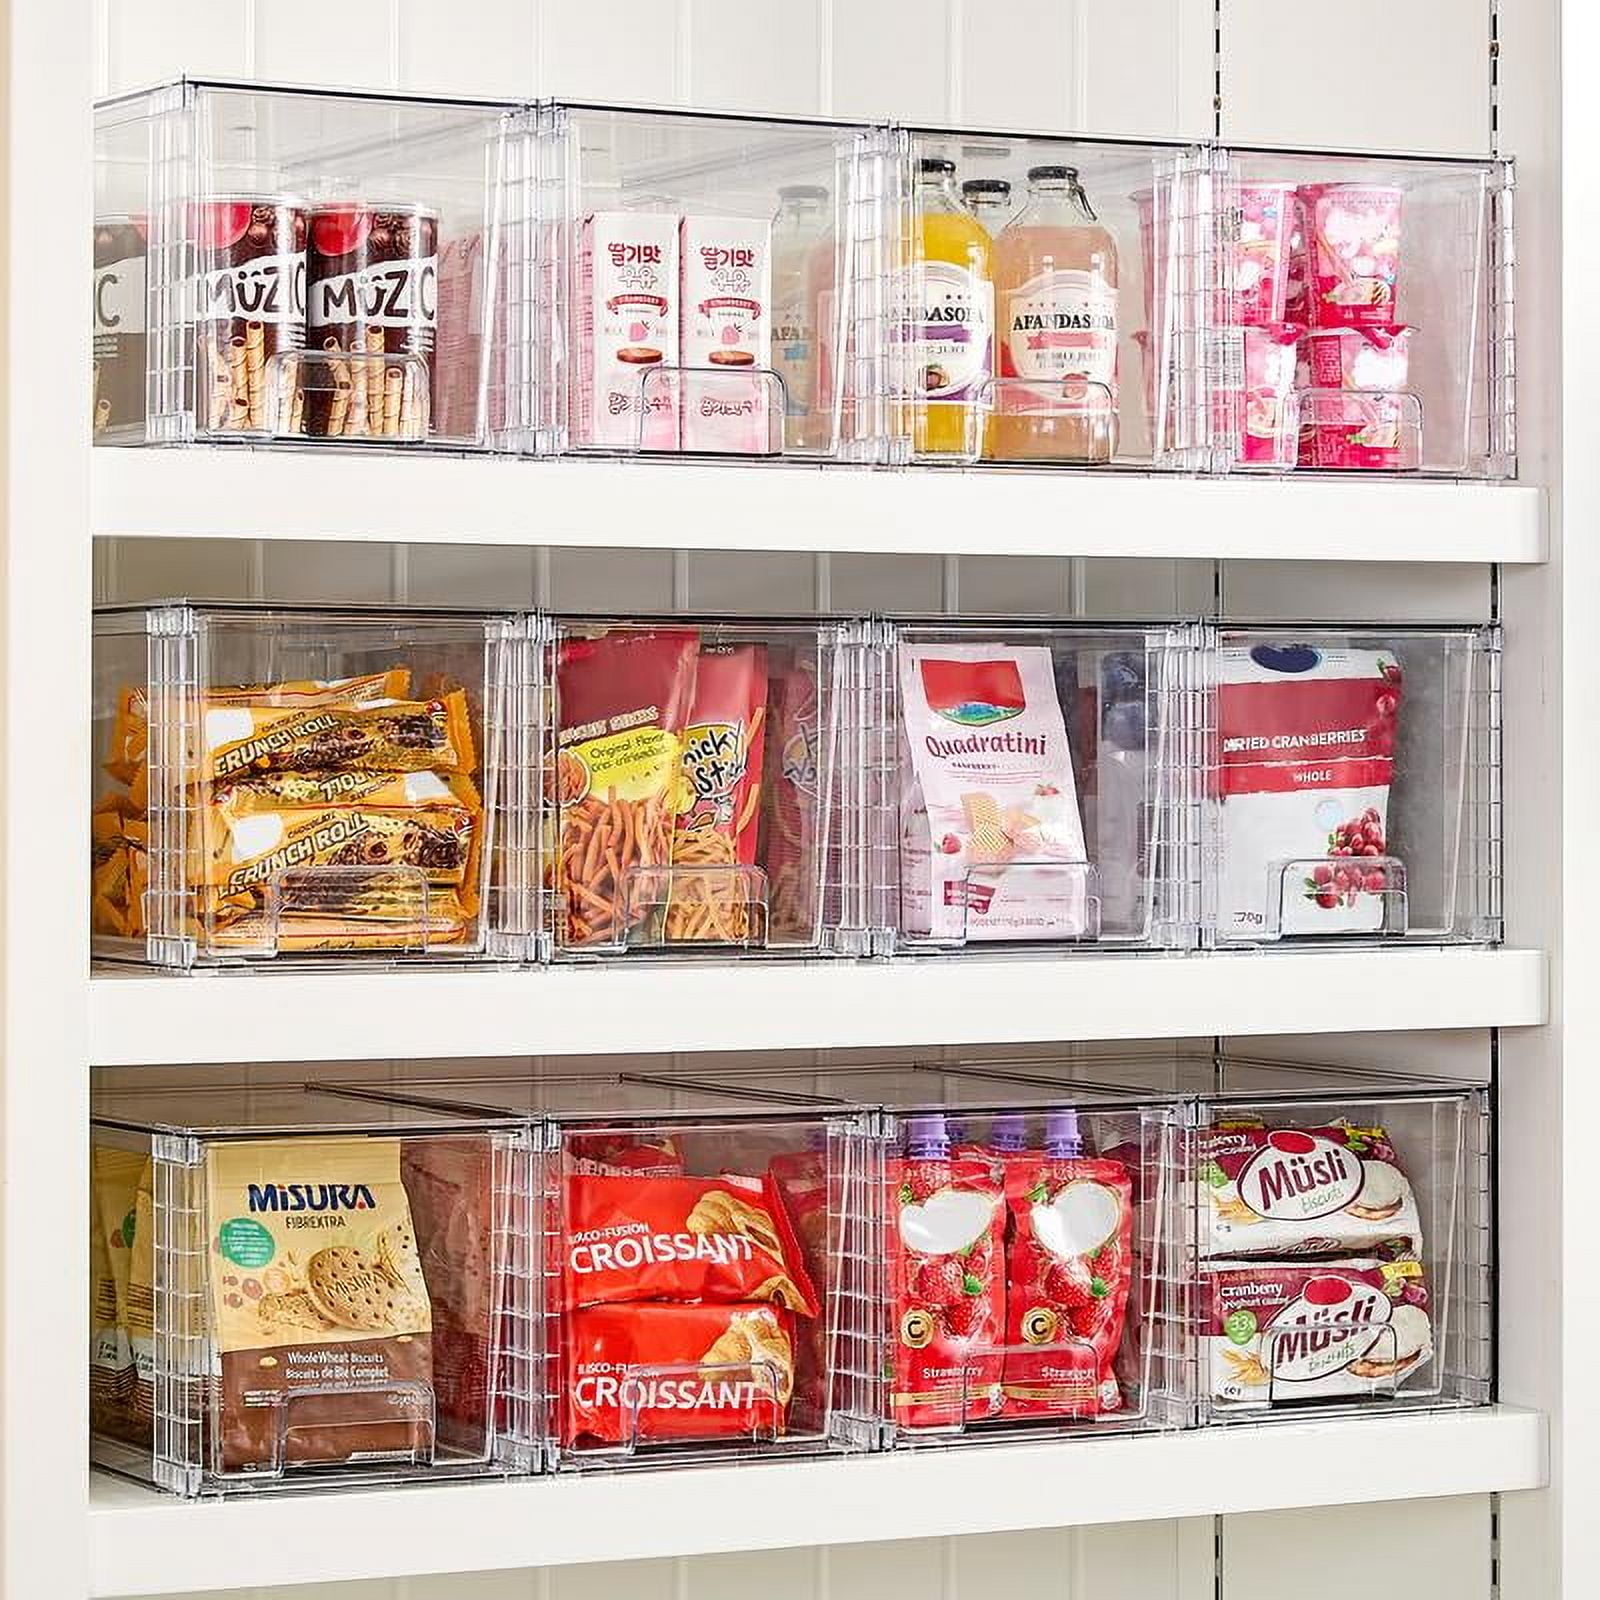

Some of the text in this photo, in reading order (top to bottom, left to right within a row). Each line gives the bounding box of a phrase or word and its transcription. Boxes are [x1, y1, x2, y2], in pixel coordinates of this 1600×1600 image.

[607, 242, 661, 267] 딸기맛
[700, 246, 755, 271] 딸기맛
[323, 265, 435, 321] MÜZC
[213, 713, 341, 778] CRUNCH ROLL
[925, 731, 1046, 760] Quadratini
[1271, 728, 1368, 749] CRANBERRIES
[1292, 769, 1333, 783] WHOLE
[229, 811, 369, 886] CRUNCH ROLL
[1258, 1148, 1347, 1211] Müsli
[569, 1232, 754, 1275] CROISSANT
[1274, 1294, 1377, 1369] Müsli
[575, 1376, 760, 1409] CROISSANT
